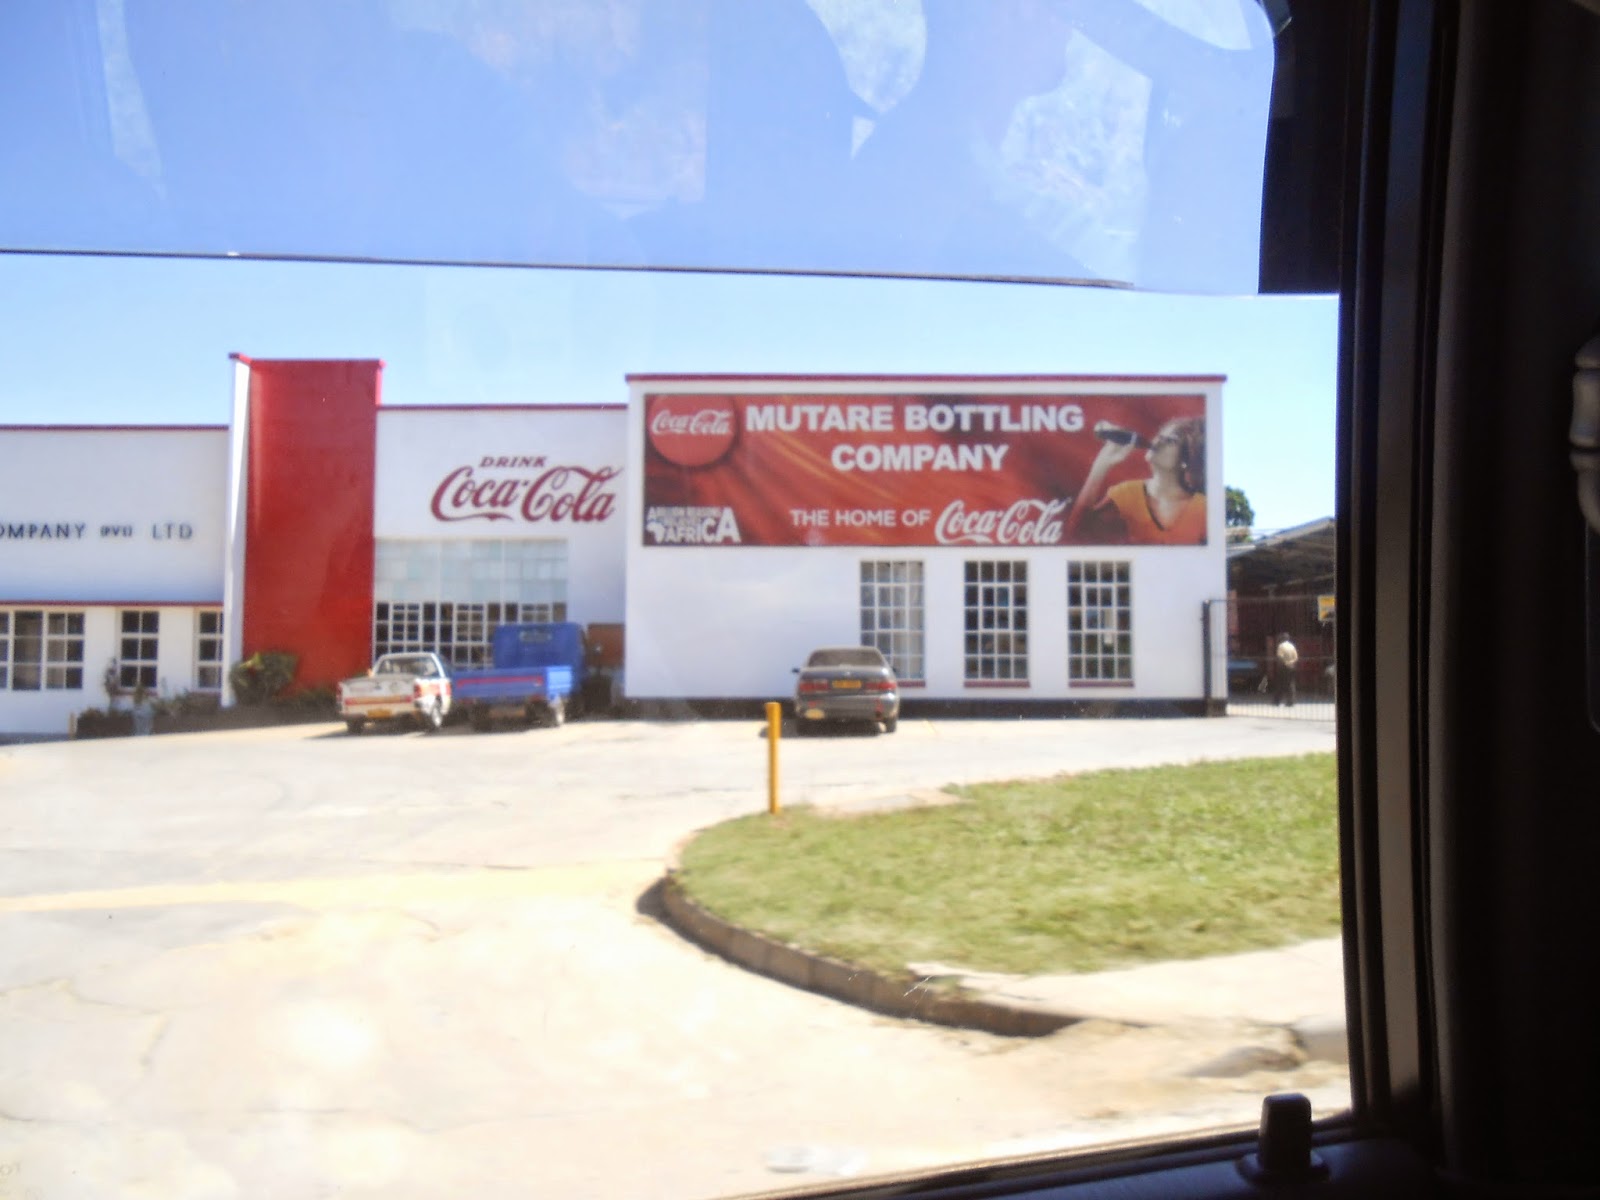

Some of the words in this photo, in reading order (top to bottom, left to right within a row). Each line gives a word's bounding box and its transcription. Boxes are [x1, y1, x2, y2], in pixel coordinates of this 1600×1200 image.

[745, 404, 894, 432] MUTARE
[904, 404, 1084, 432] BOTTLING
[480, 455, 548, 468] DRINK
[831, 444, 1009, 472] COMPANY
[790, 509, 830, 527] THE
[835, 509, 896, 527] HOME
[902, 510, 931, 528] OF
[152, 523, 193, 540] LTD
